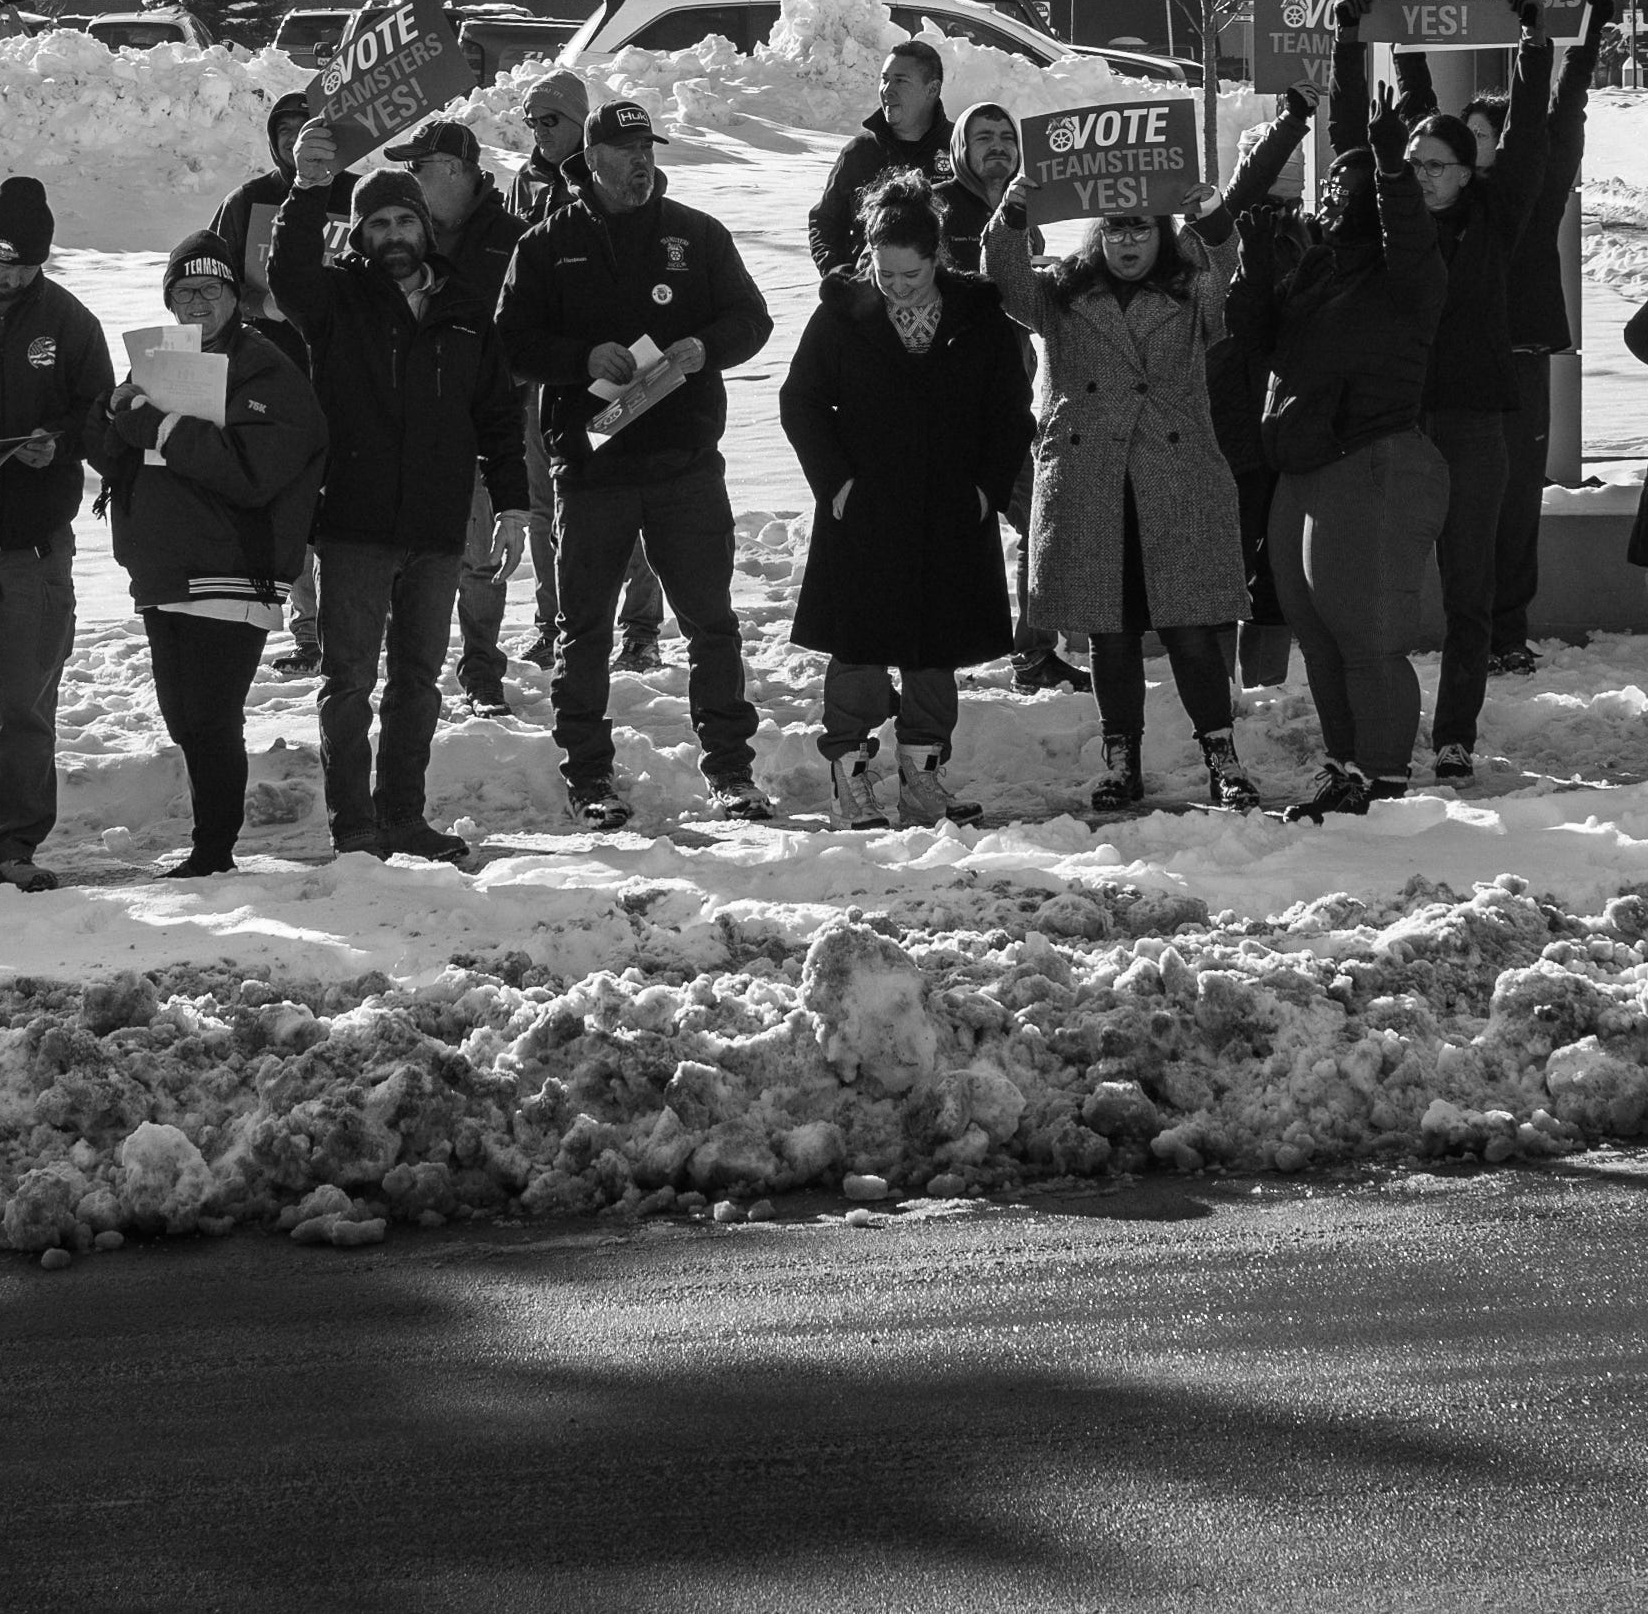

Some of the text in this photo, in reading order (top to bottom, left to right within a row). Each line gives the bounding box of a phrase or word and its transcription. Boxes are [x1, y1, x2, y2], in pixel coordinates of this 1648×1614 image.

[1401, 5, 1469, 35] YES!
[338, 3, 419, 84] VOTE
[353, 81, 428, 138] YES!
[1071, 107, 1171, 150] VOTE
[1036, 146, 1185, 184] TEAMSTERS
[1073, 176, 1150, 211] YES!
